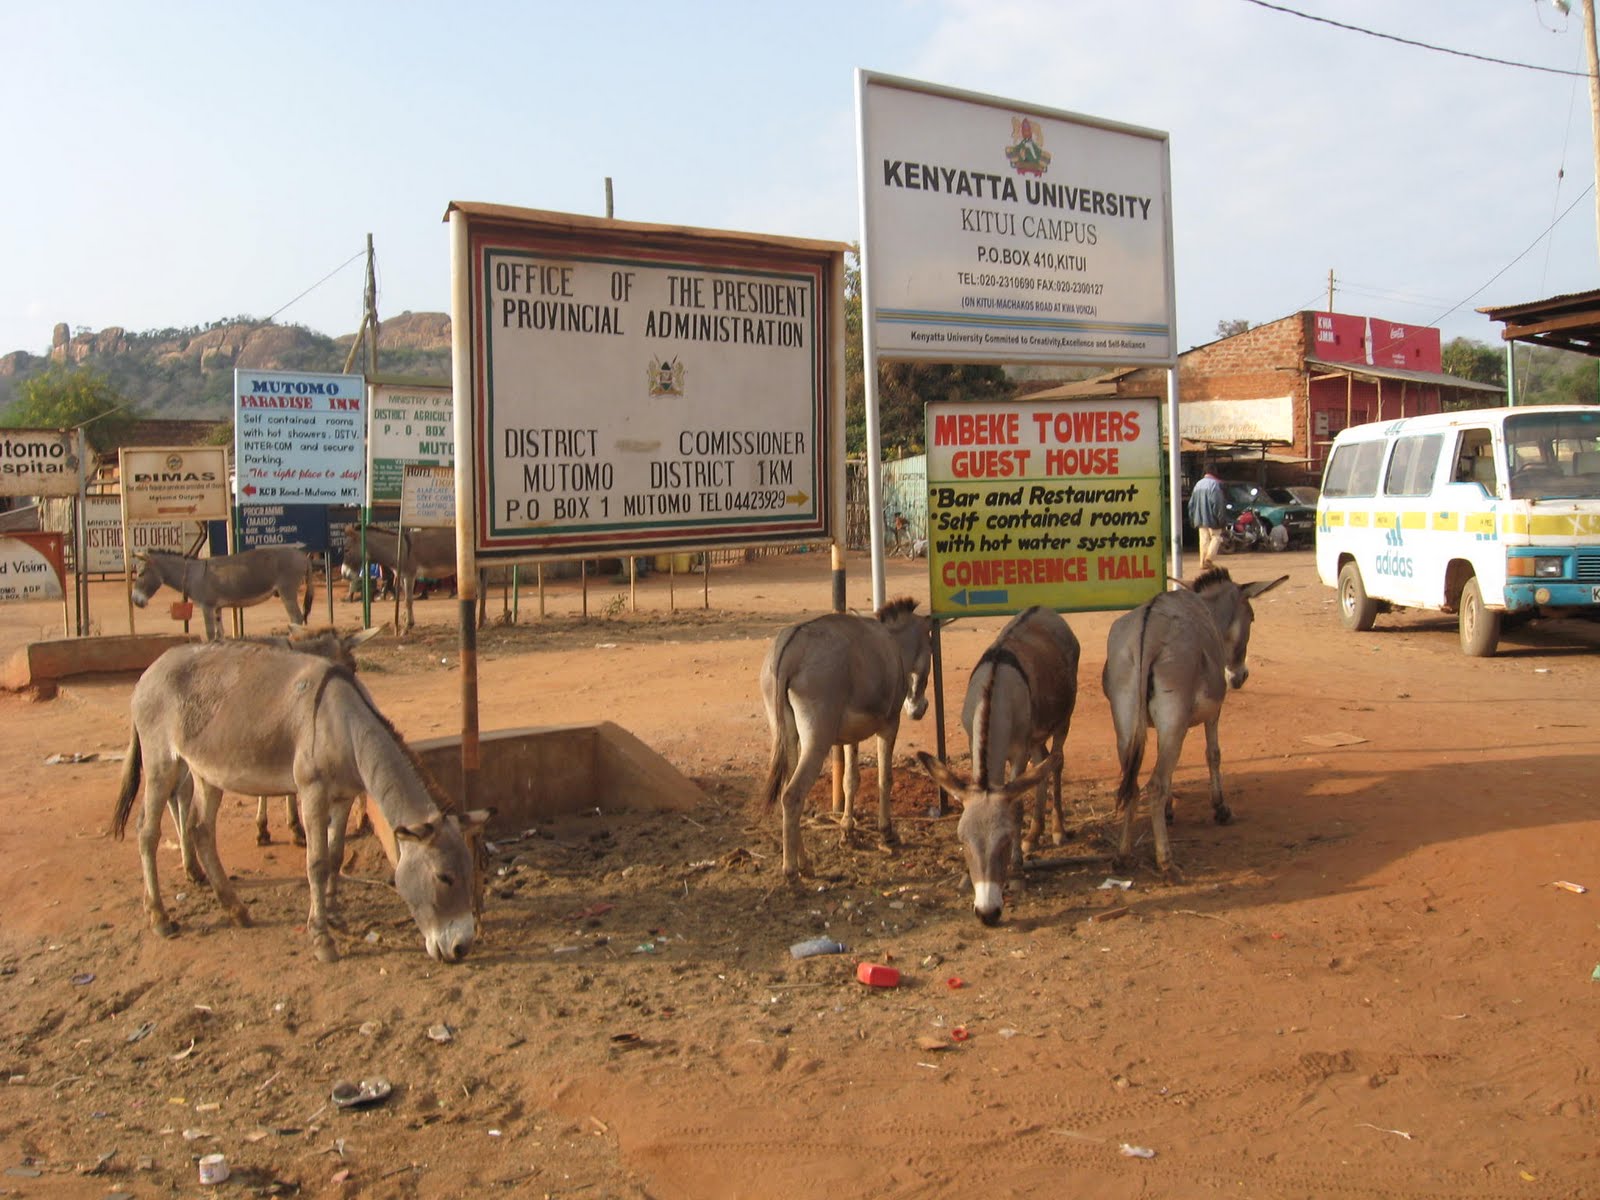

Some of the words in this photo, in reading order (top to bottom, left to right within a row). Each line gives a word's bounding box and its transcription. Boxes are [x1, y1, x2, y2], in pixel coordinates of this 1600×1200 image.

[883, 159, 1018, 203] KENYATTA
[1025, 179, 1151, 221] UNIVERSITY
[960, 208, 1016, 236] KITUI
[1022, 215, 1098, 245] CAMPUS
[977, 246, 1030, 267] P.O.BOX
[496, 262, 574, 298] OFFICE
[610, 271, 636, 302] OF
[667, 275, 706, 309] THE
[712, 278, 808, 318] PRESIDENT
[1035, 301, 1053, 312] ROAD
[1053, 303, 1061, 312] AT
[503, 298, 625, 335] PROVINCIAL
[645, 310, 804, 348] ADMINISTRATION
[911, 330, 945, 343] Kenyatta
[947, 332, 983, 345] University
[1020, 335, 1028, 345] to
[1095, 339, 1107, 348] and
[251, 380, 340, 396] MUTOMO
[240, 395, 313, 409] PARADISE
[328, 397, 360, 411] INN
[388, 394, 429, 405] MINISTRY
[432, 397, 440, 406] OF
[243, 414, 262, 425] Self
[267, 415, 316, 425] contained
[326, 418, 354, 426] rooms
[374, 409, 407, 421] DISTRICT
[243, 428, 264, 438] with
[267, 429, 282, 438] hot
[425, 425, 446, 437] BOX
[934, 413, 1019, 447] MBEKE
[1032, 411, 1141, 445] TOWERS
[244, 442, 292, 451] INTER-COM
[300, 443, 319, 451] and
[323, 444, 355, 452] secure
[504, 428, 598, 458] DISTRICT
[679, 430, 805, 456] COMISSIONER
[951, 449, 1031, 478] GUEST
[1046, 447, 1119, 476] HOUSE
[273, 468, 297, 480] right
[299, 468, 322, 480] place
[325, 469, 335, 479] to
[523, 462, 614, 493] MUTOMO
[650, 460, 735, 489] DISTRICT
[554, 496, 590, 520] BOX
[600, 496, 609, 517] 1
[624, 493, 691, 517] MUTOMO
[937, 487, 980, 509] Bar
[985, 486, 1024, 507] and
[1029, 484, 1139, 506] Restaurant
[937, 511, 980, 532] Self
[986, 507, 1083, 530] contained
[1089, 509, 1150, 527] rooms
[936, 533, 975, 553] with
[980, 534, 1012, 552] hot
[1018, 533, 1072, 551] water
[1077, 532, 1157, 552] systems
[12, 560, 47, 574] Vision
[942, 557, 1089, 587] CONFERENCE
[1097, 554, 1156, 581] HALL
[1375, 550, 1413, 578] adidas
